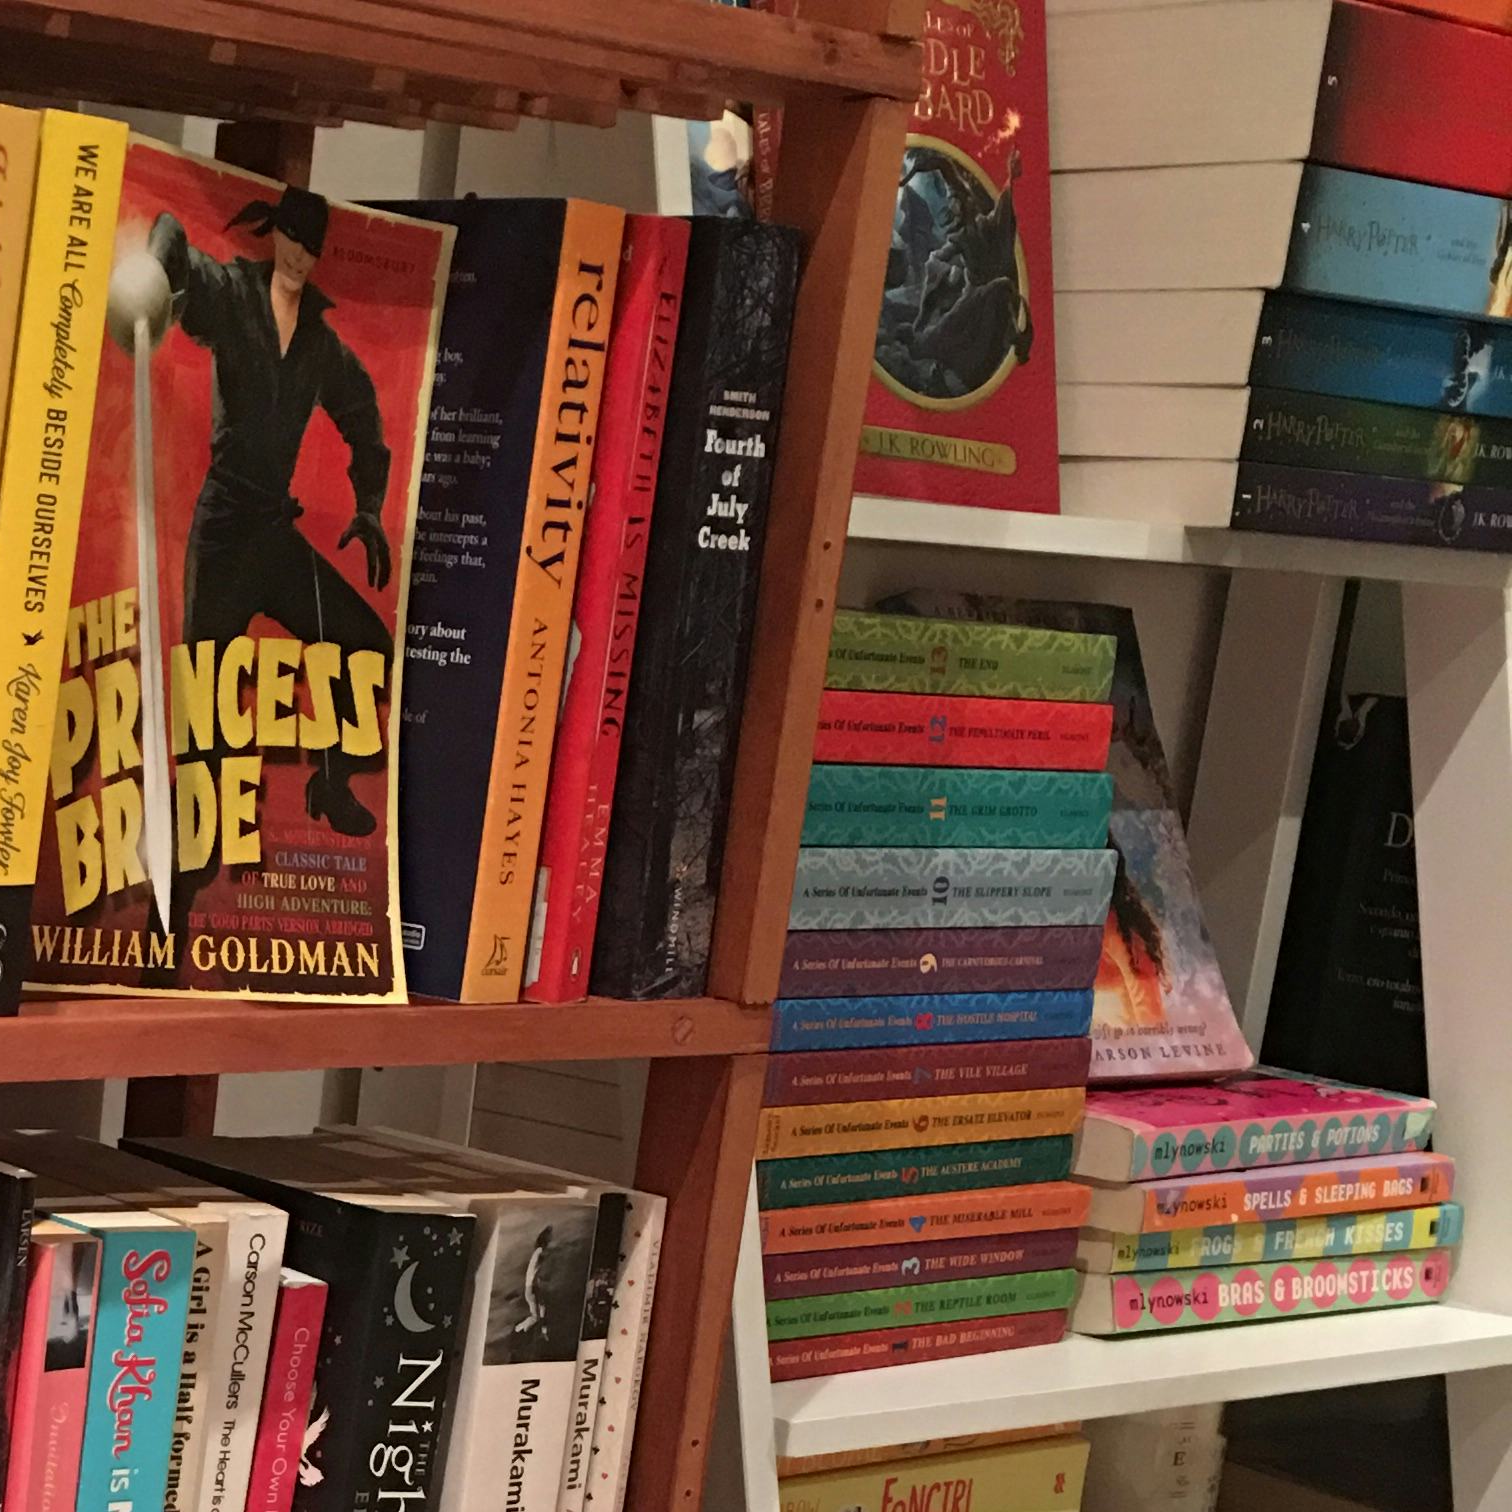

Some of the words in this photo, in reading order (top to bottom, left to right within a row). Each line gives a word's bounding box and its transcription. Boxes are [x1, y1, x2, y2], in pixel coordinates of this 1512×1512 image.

[76, 143, 99, 182] WE
[68, 186, 93, 231] ARE
[63, 234, 89, 272] ALL
[44, 279, 83, 400] Completely
[526, 260, 606, 589] relativity
[39, 407, 68, 485] BESIDE
[704, 430, 766, 458] Fourth
[907, 438, 998, 469] ROWLING
[722, 464, 742, 486] of
[707, 494, 749, 524] July
[23, 493, 58, 615] OURSELVES
[697, 527, 751, 551] Creek
[514, 618, 548, 770] ANTONIA
[498, 783, 527, 887] HAYES
[275, 851, 330, 870] CLASSIC
[334, 855, 367, 872] TALE
[261, 871, 295, 890] TRUE
[299, 874, 336, 893] LOVE
[952, 886, 972, 897] THE
[237, 894, 275, 910] HIGH
[32, 924, 176, 969] WILLIAM
[191, 935, 379, 978] GOLDMAN
[934, 1067, 956, 1080] THE
[1249, 1129, 1304, 1154] PARTIES
[1327, 1123, 1380, 1145] POTIONS
[921, 1166, 937, 1177] THE
[1243, 1187, 1292, 1212] SPELLS
[1314, 1180, 1376, 1205] SLEEPING
[1382, 1178, 1413, 1197] BAGS
[925, 1257, 945, 1269] THE
[915, 1299, 935, 1312] THE
[986, 1292, 1017, 1305] ROOM
[1217, 1281, 1265, 1309] BRAS
[1291, 1267, 1413, 1300] BROOMSTICKS
[912, 1336, 932, 1348] THE
[565, 1357, 600, 1491] Murakami
